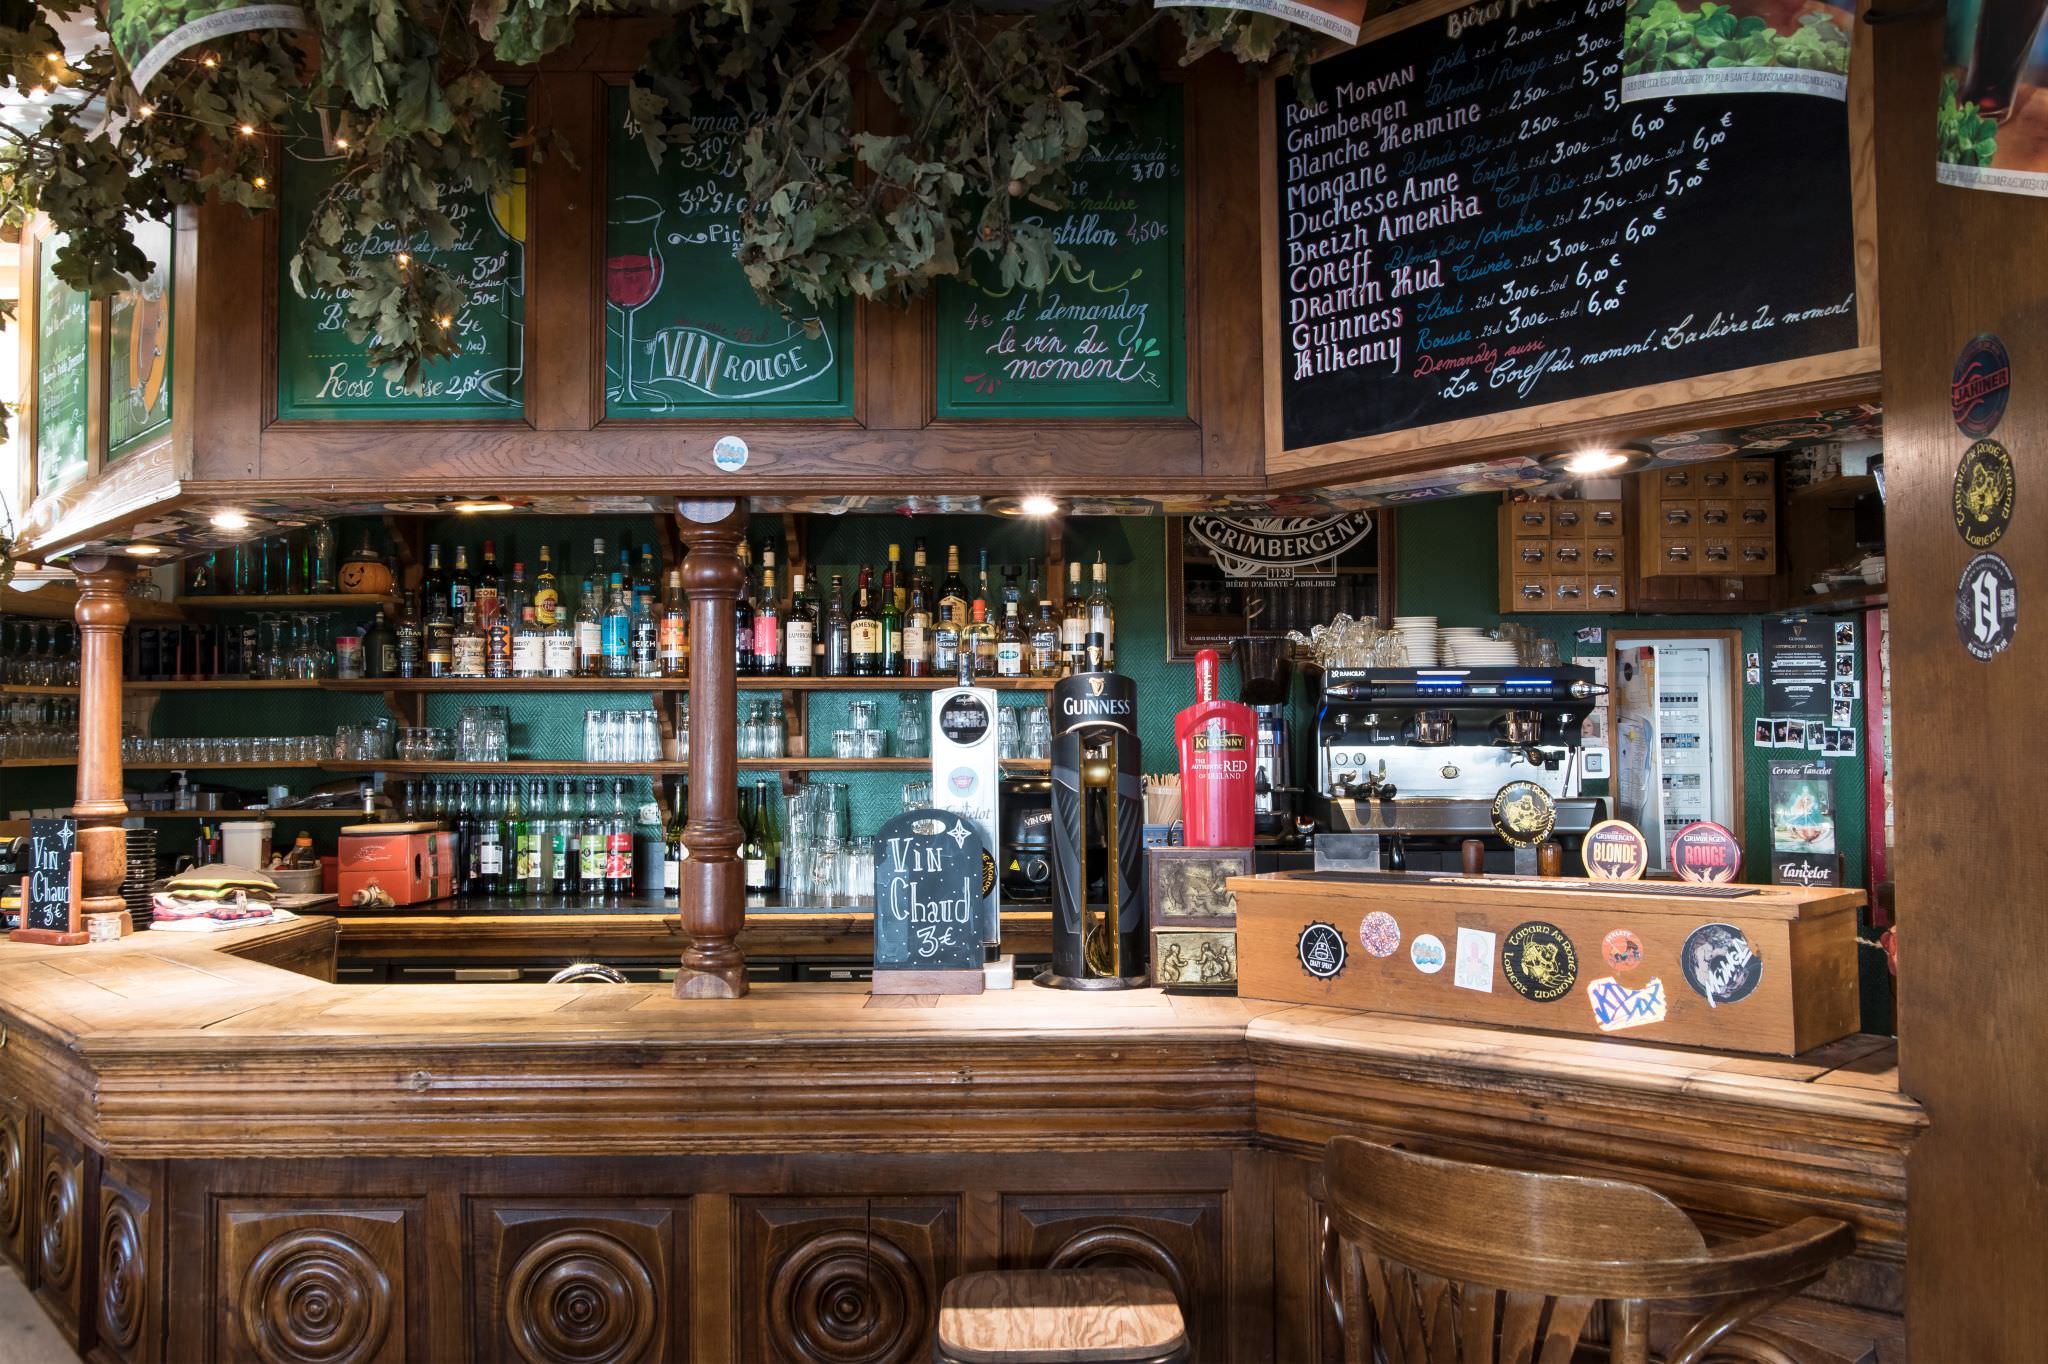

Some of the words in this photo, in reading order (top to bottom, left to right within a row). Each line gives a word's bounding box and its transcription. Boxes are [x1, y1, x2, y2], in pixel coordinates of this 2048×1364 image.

[1287, 139, 1371, 183] Blanche
[1287, 161, 1388, 212] Morgane
[1287, 187, 1399, 241] Duchesse
[1401, 171, 1461, 207] Anne
[1287, 223, 1370, 268] Breizh
[1377, 194, 1483, 243] Amerika
[1289, 249, 1374, 297] Coreff
[1000, 293, 1028, 323] et
[1292, 306, 1404, 350] Guinness
[1580, 328, 1656, 368] moment
[1781, 292, 1854, 324] moment
[657, 331, 727, 393] VIN
[722, 346, 808, 383] ROUGE
[1002, 347, 1146, 382] moment
[1294, 335, 1402, 382] Kilkenny
[1413, 341, 1500, 379] Demandez
[1504, 335, 1547, 357] aussi
[1205, 518, 1356, 558] GRIMBERGEN
[1269, 567, 1291, 578] 1128
[1063, 697, 1131, 716] GUINNESS
[1223, 760, 1248, 772] RED
[32, 836, 60, 870] Vin
[888, 837, 944, 873] Vin
[1593, 842, 1639, 865] BLONDE
[1684, 844, 1728, 867] ROUGE
[889, 876, 971, 925] Chaud
[916, 926, 957, 958] 3€
